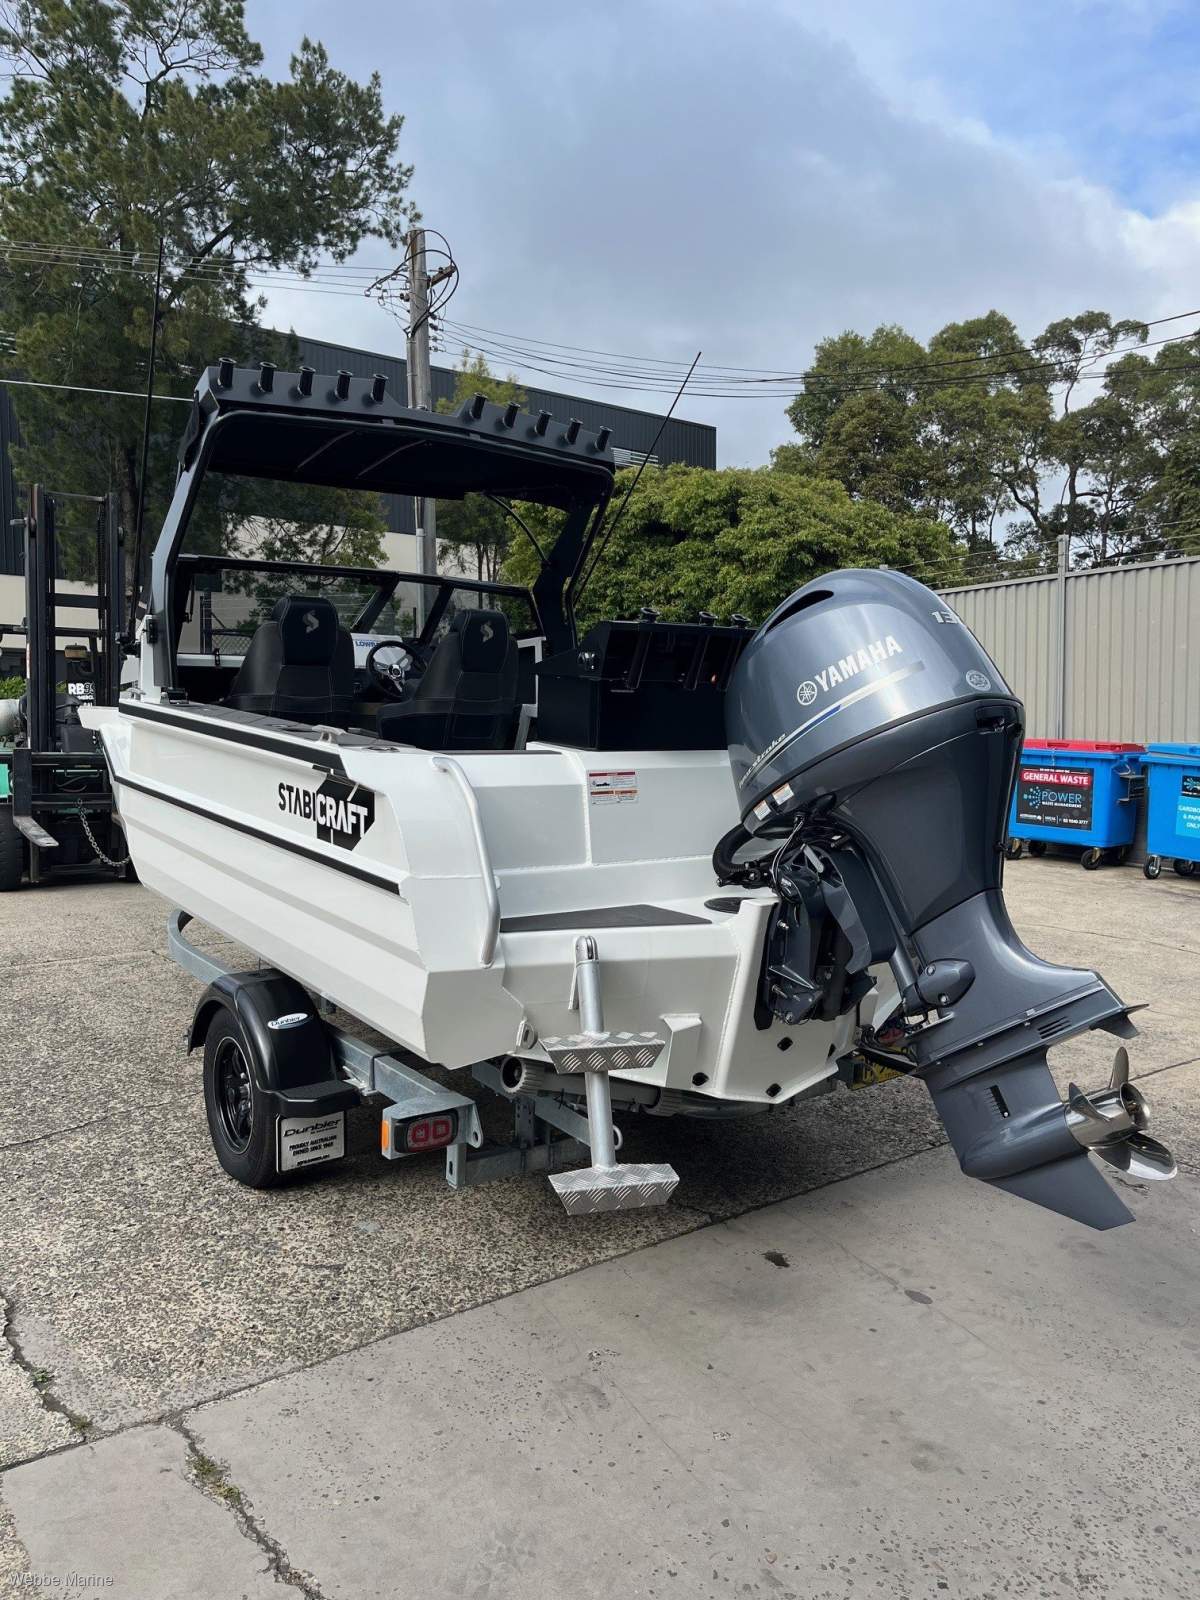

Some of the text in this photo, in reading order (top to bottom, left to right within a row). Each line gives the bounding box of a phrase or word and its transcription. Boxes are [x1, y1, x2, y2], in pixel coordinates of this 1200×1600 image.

[814, 635, 903, 692] YAMAHA
[1023, 772, 1089, 785] GENERAL WASTE
[1041, 791, 1082, 804] POWER
[278, 782, 368, 839] STABICRAFT
[283, 1119, 342, 1138] Dunbier
